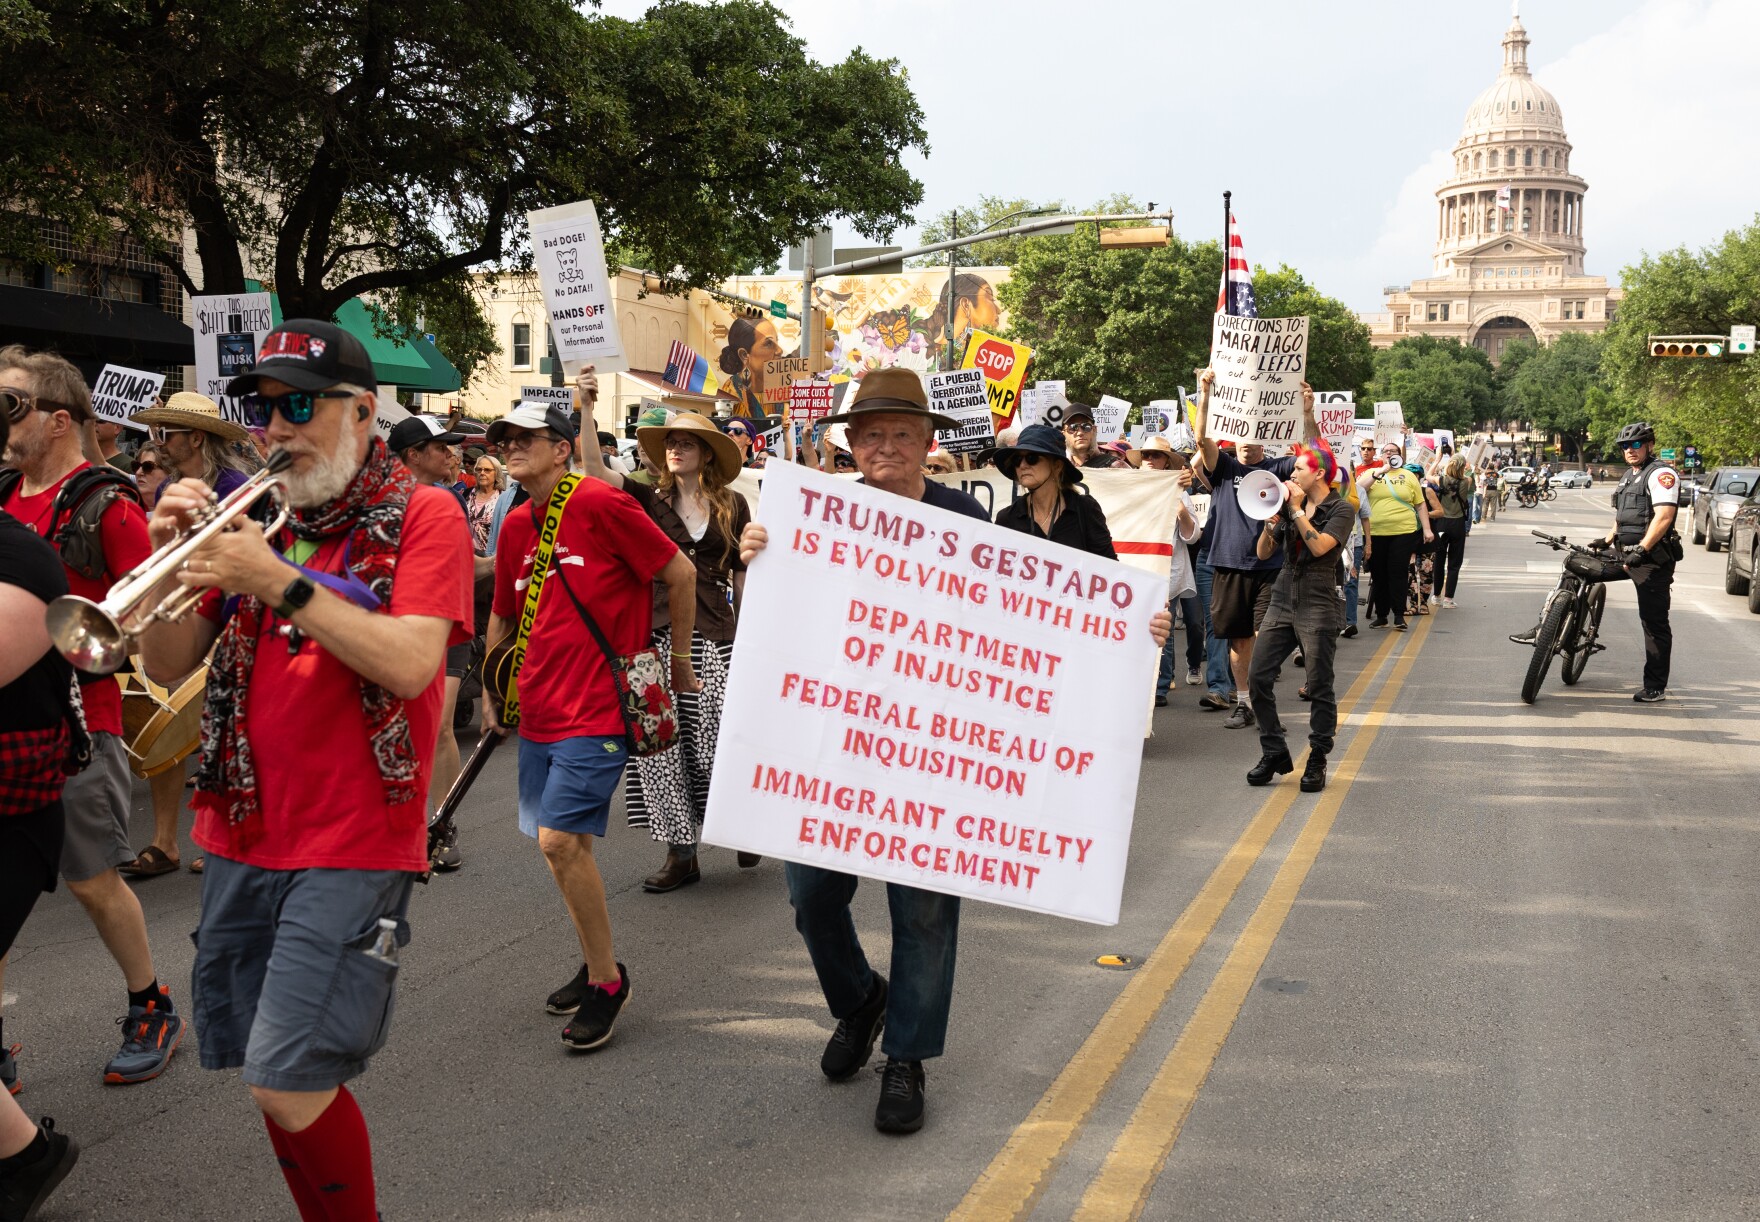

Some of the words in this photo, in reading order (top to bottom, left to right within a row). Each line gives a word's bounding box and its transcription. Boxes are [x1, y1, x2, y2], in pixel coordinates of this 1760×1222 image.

[543, 237, 558, 248] Bad
[560, 232, 586, 245] DOGE!
[555, 288, 565, 297] No
[567, 283, 594, 295] DATA!!
[227, 298, 241, 313] THIS
[552, 307, 585, 320] HANDS
[200, 309, 225, 335] $H!T
[243, 308, 270, 331] REEKS
[572, 320, 604, 333] Personal
[1217, 314, 1282, 334] DIRECTIONS
[1287, 318, 1304, 332] TO:
[564, 335, 605, 346] Information
[1220, 329, 1260, 353] MARA
[1264, 333, 1304, 354] LAGO
[766, 358, 808, 374] SILENCE
[977, 348, 1014, 371] STOP
[1237, 355, 1248, 364] all
[1257, 354, 1302, 372] LEFTS
[781, 374, 792, 386] IS
[945, 371, 981, 385] PUEBLO
[1228, 370, 1244, 378] out
[1250, 372, 1263, 381] of
[1266, 372, 1283, 384] the
[98, 370, 160, 403] TRUMP:
[208, 379, 233, 396] SMELL
[524, 388, 570, 399] IMPEACH
[765, 386, 792, 401] VIOLE
[794, 388, 810, 398] SOME
[811, 388, 826, 397] CUTS
[933, 382, 982, 399] DERROTARÁ
[795, 398, 811, 408] DON'T
[812, 398, 828, 408] HEAL
[947, 395, 987, 410] AGENDA
[1258, 390, 1298, 406] HOUSE
[91, 395, 127, 418] HANDS
[1092, 408, 1119, 417] PROCESS
[1222, 402, 1243, 413] then
[1246, 406, 1258, 416] its
[1263, 409, 1287, 418] your
[1321, 409, 1353, 424] DUMP
[938, 430, 951, 440] DE
[953, 424, 991, 438] TRUMP!
[1101, 426, 1117, 434] LAW
[1213, 413, 1250, 437] THIRD
[1254, 420, 1296, 440] REICH
[753, 430, 785, 452] DEP
[528, 549, 550, 602] LINE
[542, 515, 558, 546] DO
[550, 472, 581, 510] NOT
[800, 487, 959, 557] TRUMP'S
[971, 543, 1133, 609] GESTAPO
[792, 528, 820, 555] IS
[830, 541, 988, 605] EVOLVING
[1001, 588, 1073, 629] WITH
[1081, 613, 1127, 641] HIS
[848, 599, 1062, 678] DEPARTMENT
[844, 636, 885, 667] OF
[893, 649, 1053, 714] INJUSTICE
[781, 673, 921, 731] FEDERAL
[930, 713, 1047, 763] BUREAU
[1055, 746, 1094, 775] OF
[842, 727, 1027, 797] INQUISITION
[752, 764, 946, 831] IMMIGRANT
[955, 815, 1093, 863] CRUELTY
[799, 817, 1041, 890] ENFORCEMENT
